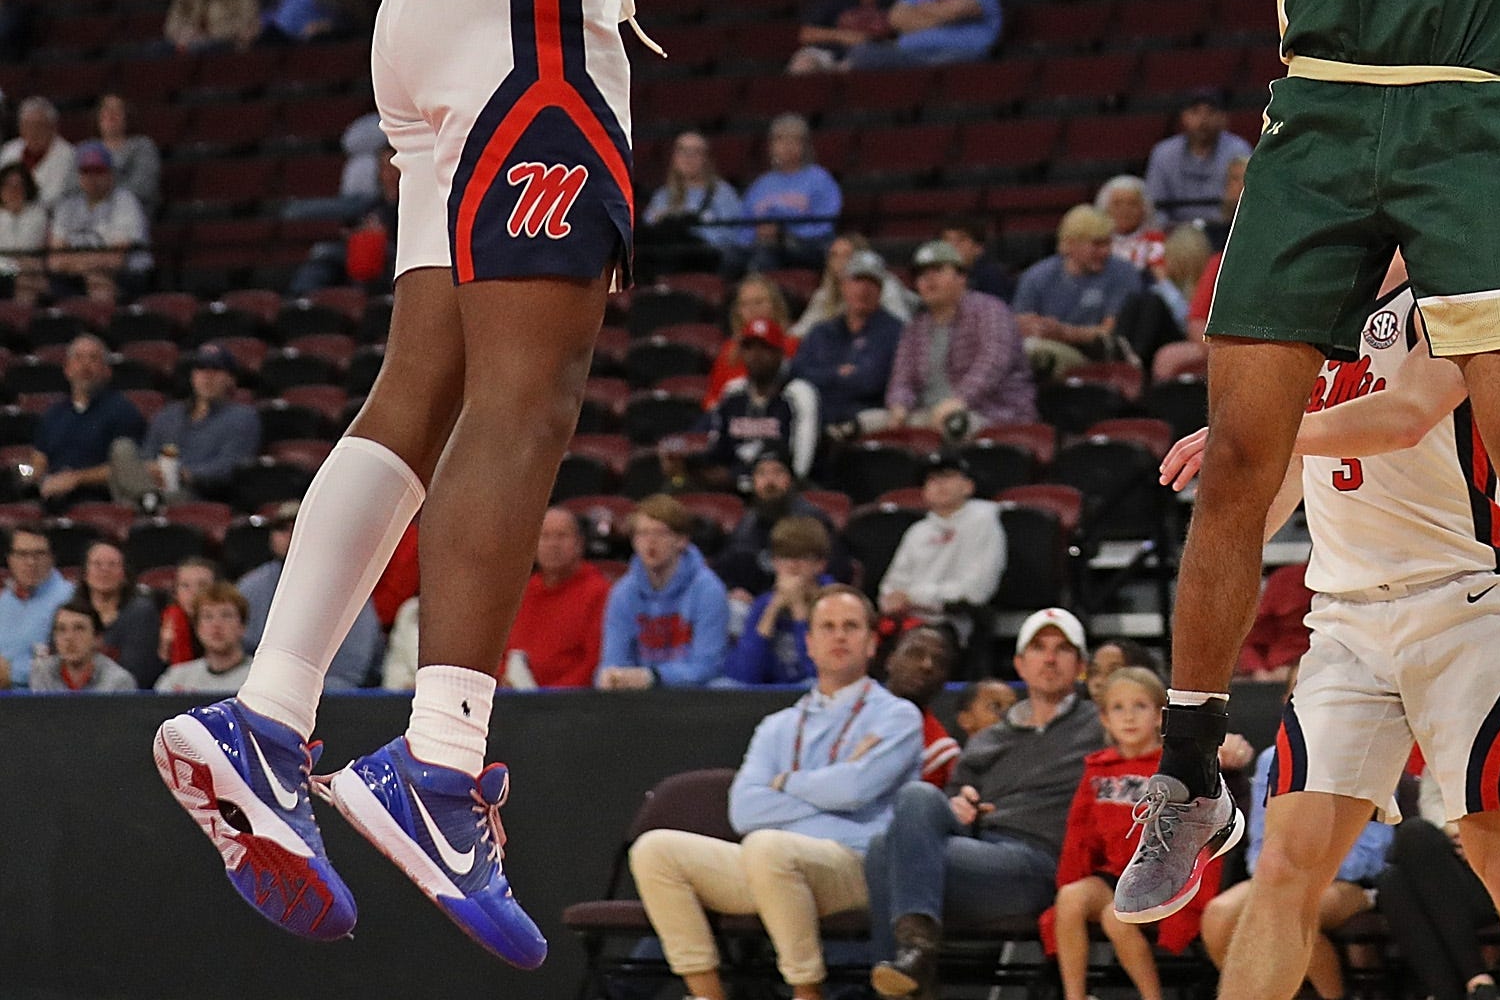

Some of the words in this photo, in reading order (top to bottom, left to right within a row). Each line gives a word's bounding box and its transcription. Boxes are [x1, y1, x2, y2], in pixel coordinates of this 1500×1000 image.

[506, 161, 589, 240] M
[1372, 311, 1397, 340] SEC
[1332, 457, 1364, 491] 3
